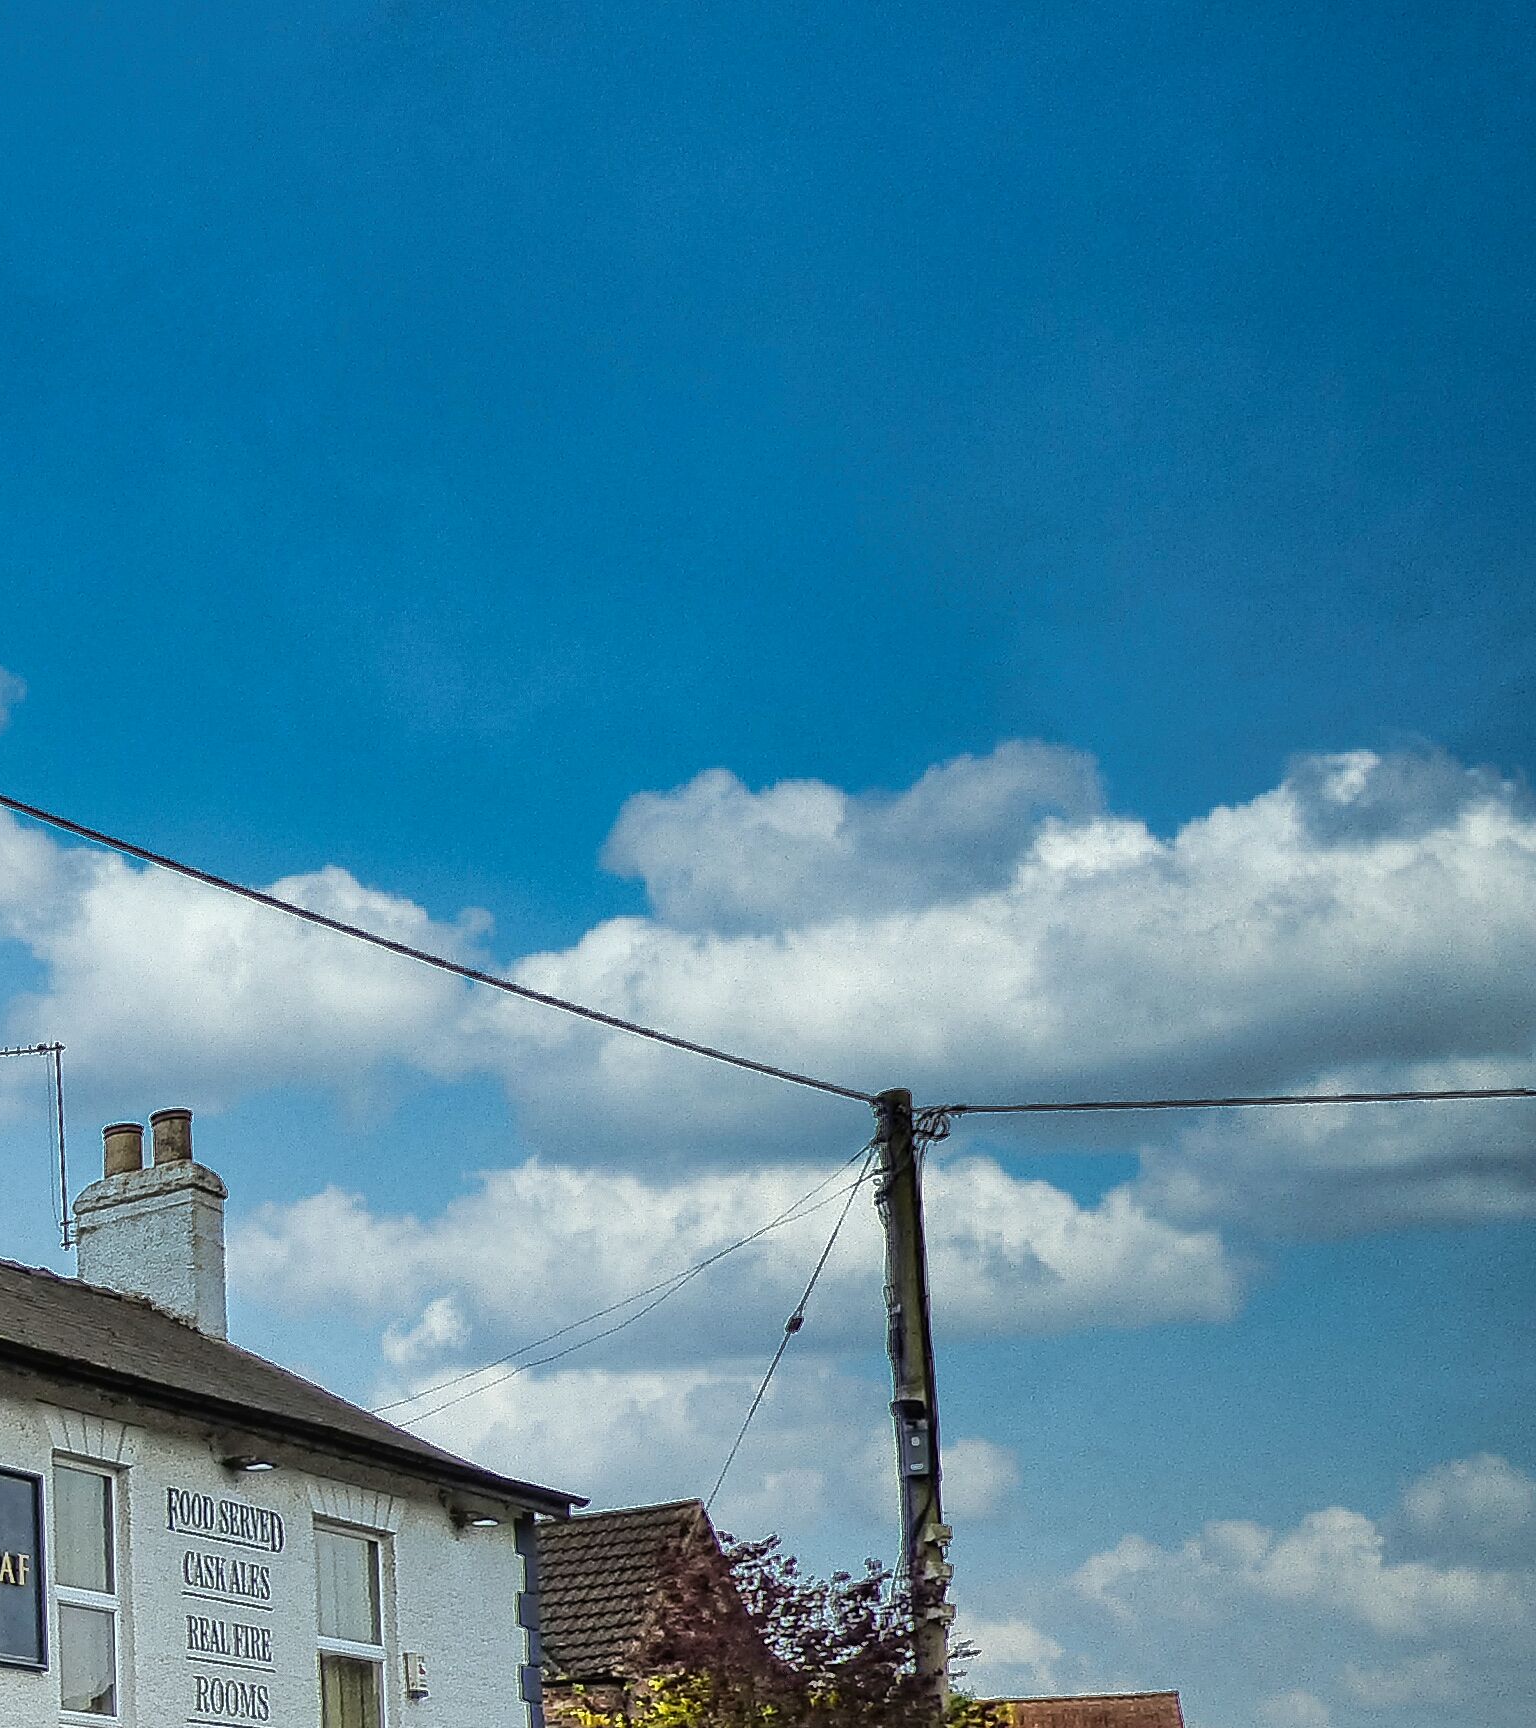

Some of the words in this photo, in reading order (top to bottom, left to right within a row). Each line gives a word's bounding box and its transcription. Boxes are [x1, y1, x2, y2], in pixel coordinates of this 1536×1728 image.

[166, 1487, 215, 1531] FOOD
[218, 1500, 285, 1553] SERVED
[183, 1551, 227, 1593] CASK
[229, 1559, 271, 1601] ALES
[186, 1615, 230, 1655] REAL
[232, 1623, 272, 1663] FIRE
[193, 1675, 270, 1722] ROOMS
